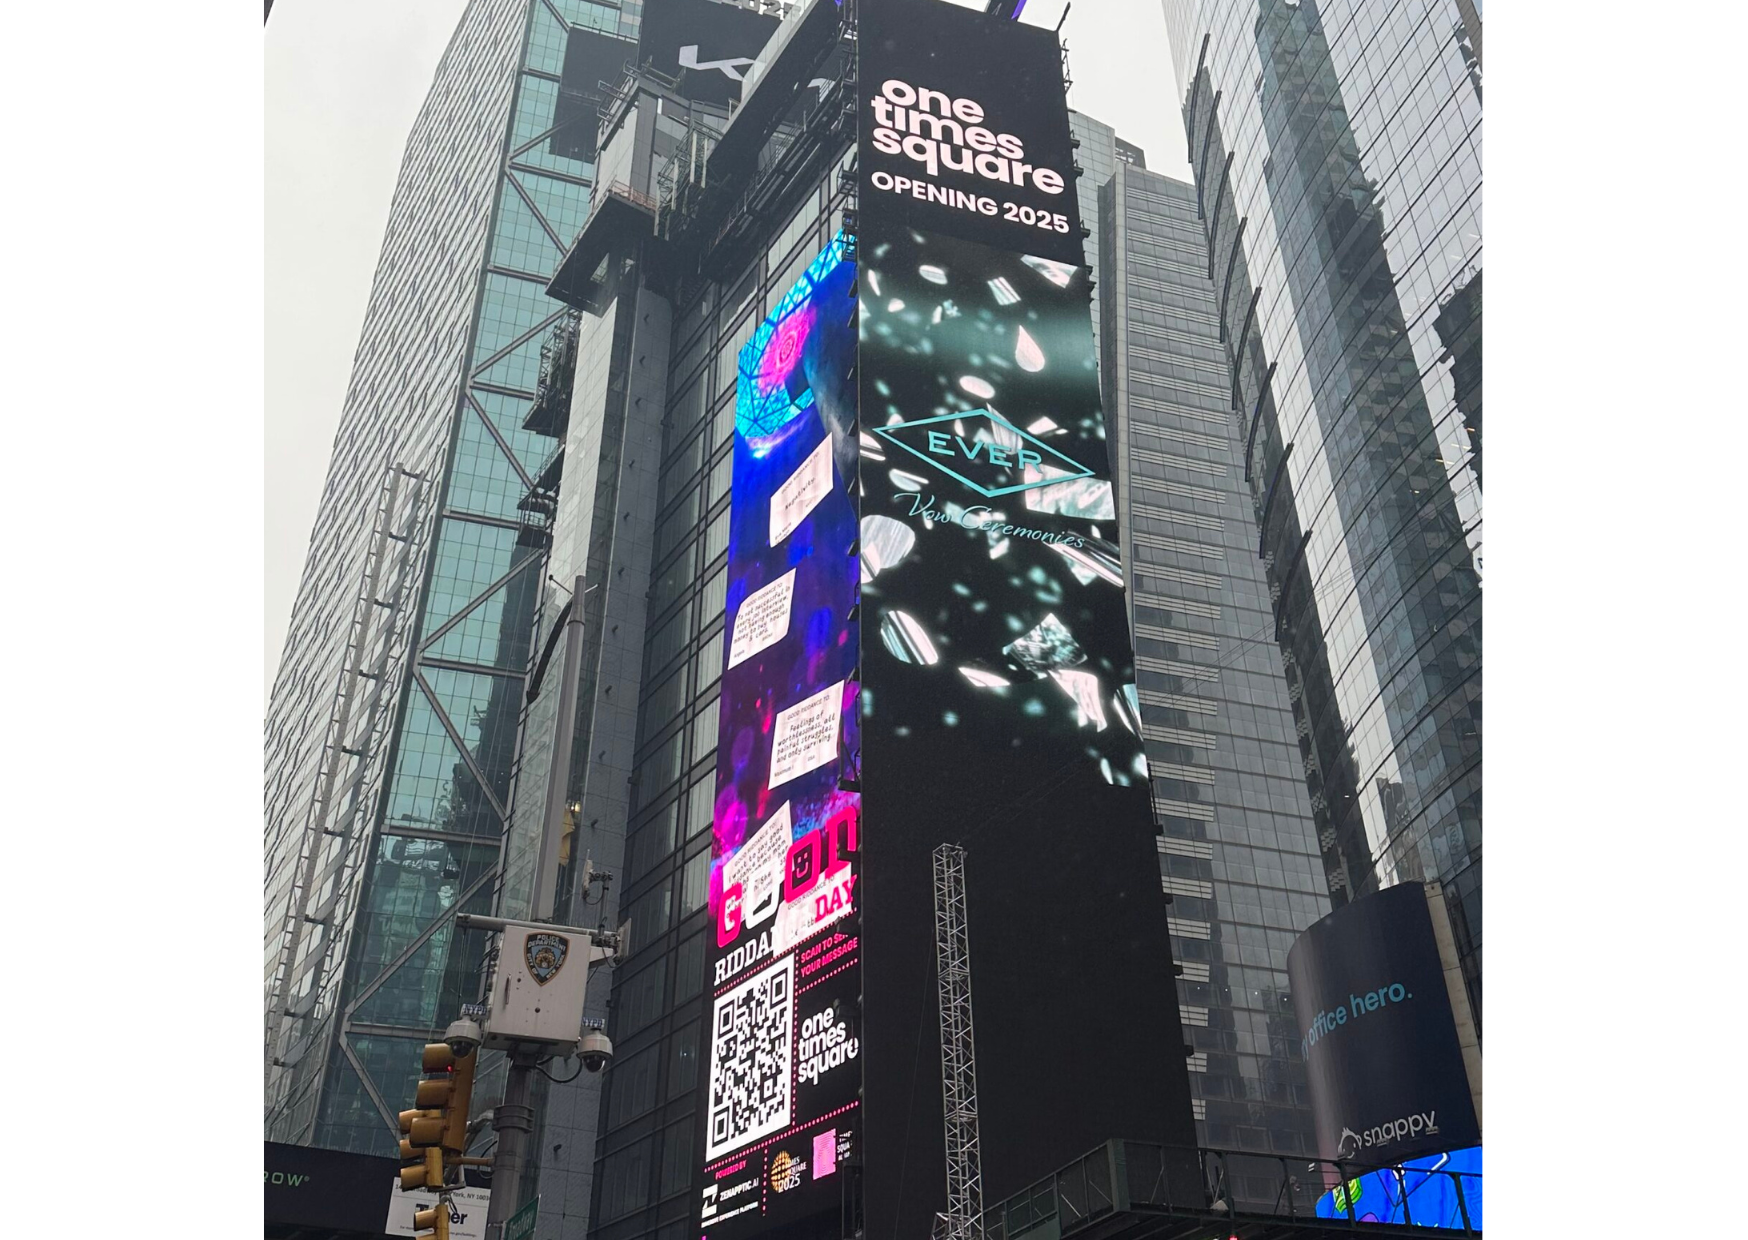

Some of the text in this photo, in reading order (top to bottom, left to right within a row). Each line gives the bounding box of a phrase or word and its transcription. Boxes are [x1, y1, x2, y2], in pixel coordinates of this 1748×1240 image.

[881, 79, 984, 124] one
[871, 95, 1025, 160] times
[872, 127, 1065, 195] square
[871, 171, 1070, 234] OPENING 2025
[928, 430, 1044, 474] EVER
[893, 492, 1086, 548] Vow Ceremonies
[527, 939, 567, 951] DEPARTMENT
[714, 925, 775, 986] RIDDA
[814, 874, 857, 923] DAY
[800, 943, 821, 963] SCAN
[822, 937, 833, 951] TO
[800, 936, 858, 978] YOUR MESSAGE
[801, 1007, 835, 1038] one
[1308, 1006, 1347, 1046] office
[1349, 983, 1413, 1018] hero.
[797, 1021, 846, 1062] times
[797, 1036, 859, 1086] square
[1363, 1110, 1435, 1147] snappy
[778, 1173, 801, 1193] 2025
